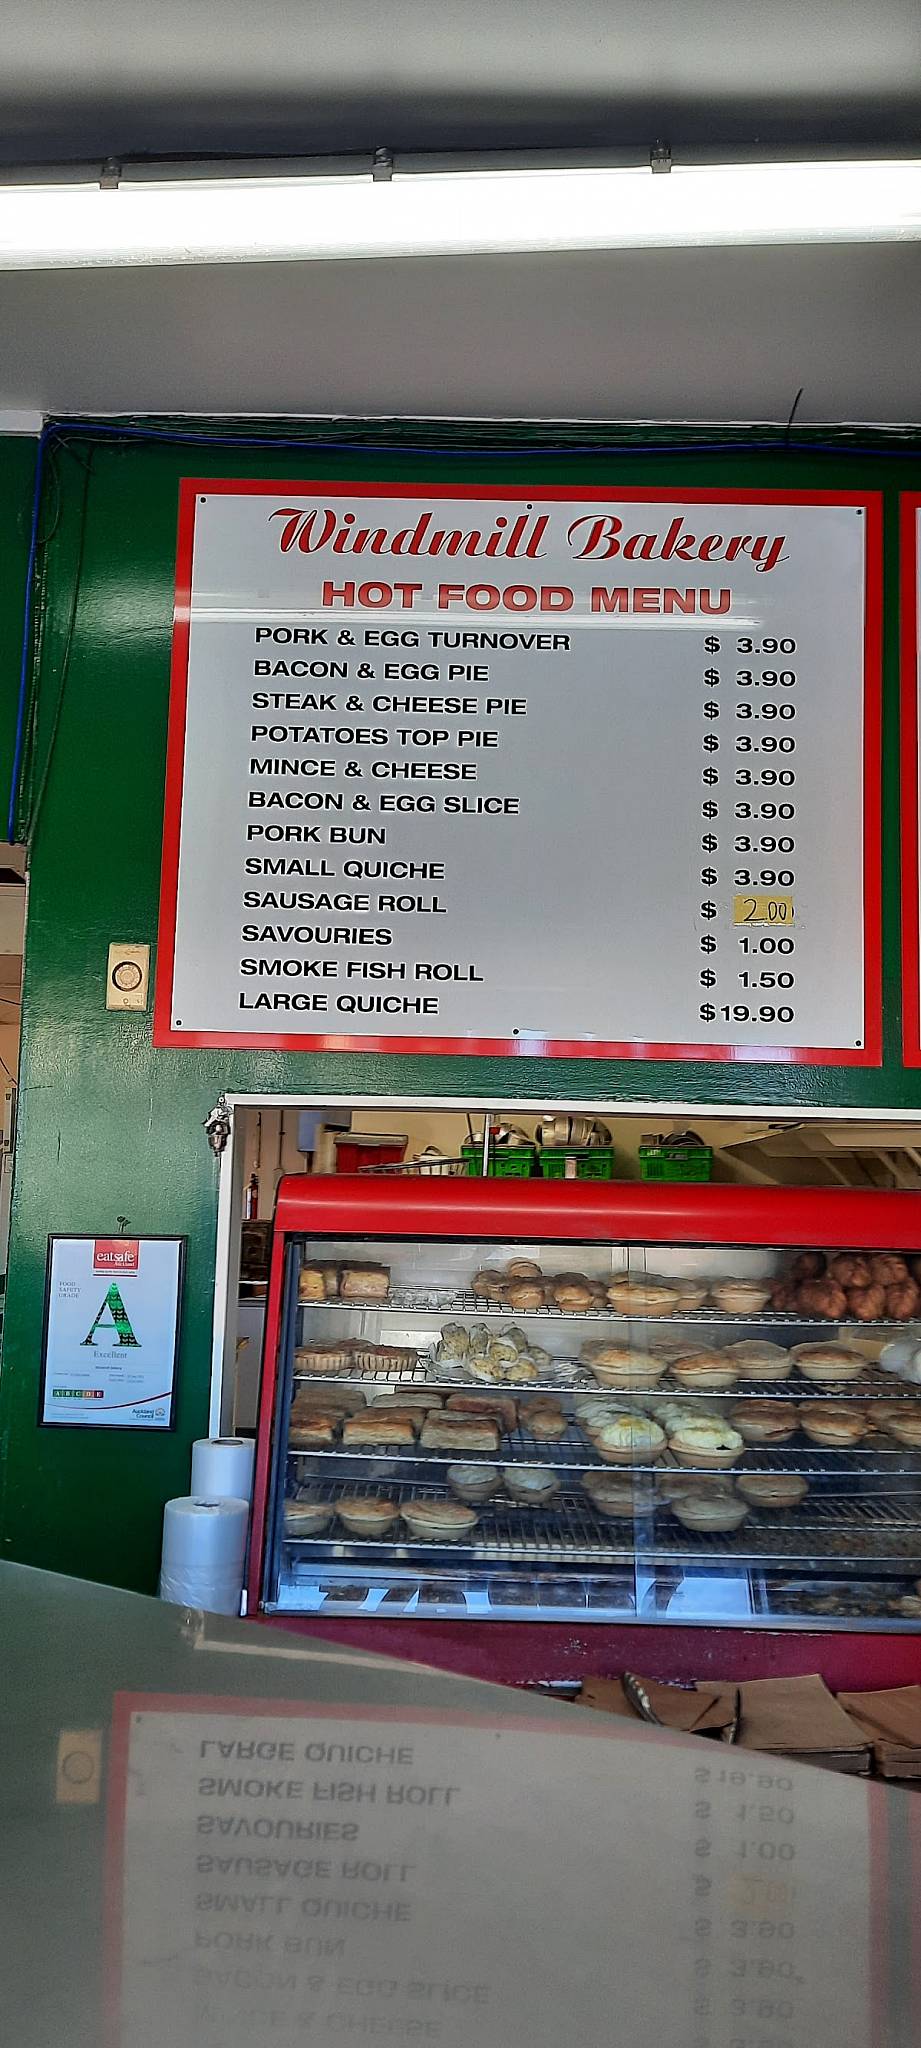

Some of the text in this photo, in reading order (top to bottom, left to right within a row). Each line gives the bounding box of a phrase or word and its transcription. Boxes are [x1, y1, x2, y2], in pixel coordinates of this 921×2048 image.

[268, 507, 790, 573] Windmill Bakery
[321, 580, 731, 615] HOT FOOD MENU
[255, 627, 796, 655] PORK & EGG TURNOVER $ 3.90
[254, 659, 796, 688] BACON & EGG PIE $ 3.90
[252, 692, 796, 721] STEAK & CHEESE PIE $ 3.90
[251, 725, 796, 754] POTATOES TOP PIE $ 3.90
[250, 758, 795, 787] MINCE & CHEESE $ 3.90
[248, 791, 795, 820] BACON & EGG SLICE $ 3.90
[247, 824, 795, 854] PORK BUN $ 3.90
[245, 857, 795, 887] SMALL QUICHE $ 3.90
[243, 891, 717, 921] SAUSAGE ROLL $
[241, 924, 795, 955] SAVOURIES $ 1.00
[240, 958, 795, 989] SMOKE FISH ROLL $ 1.50
[239, 992, 328, 1012] LARGE
[336, 995, 439, 1014] QUICHE
[96, 1250, 135, 1262] eatsafe
[79, 1282, 143, 1347] A
[93, 1351, 128, 1359] Excellent
